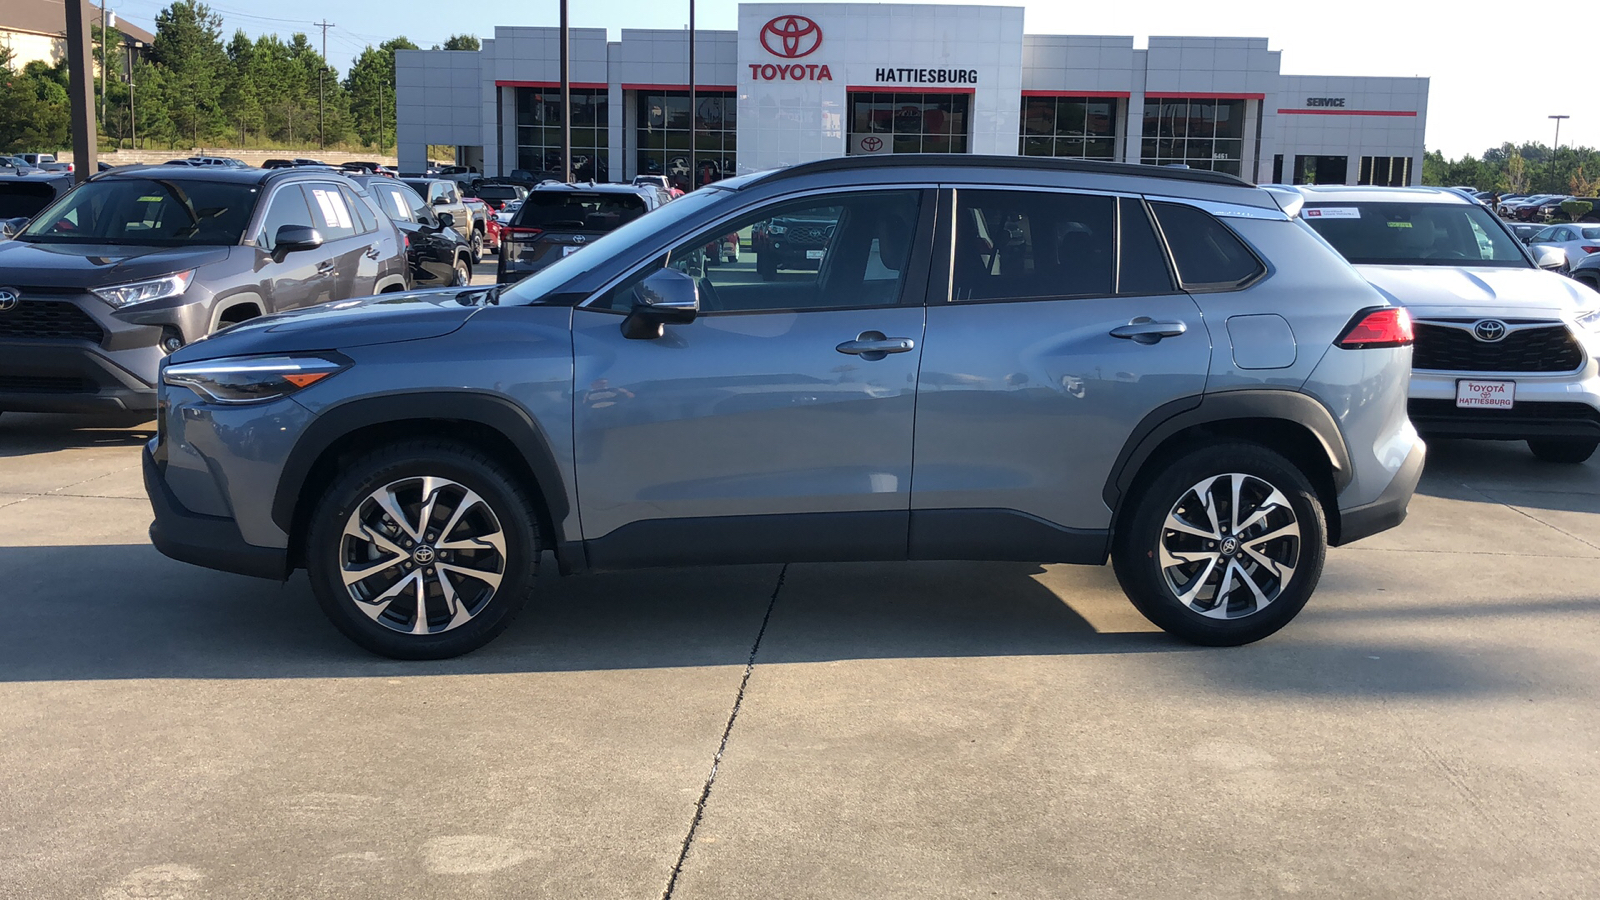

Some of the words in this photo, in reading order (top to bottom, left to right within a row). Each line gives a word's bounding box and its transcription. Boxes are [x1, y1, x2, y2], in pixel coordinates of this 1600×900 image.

[749, 64, 832, 81] TOYOTA
[876, 68, 978, 84] HATTIESBURG
[1306, 97, 1346, 107] SERVICE
[1468, 384, 1505, 393] TOYOTA
[1459, 397, 1511, 406] HATTIESBURG
